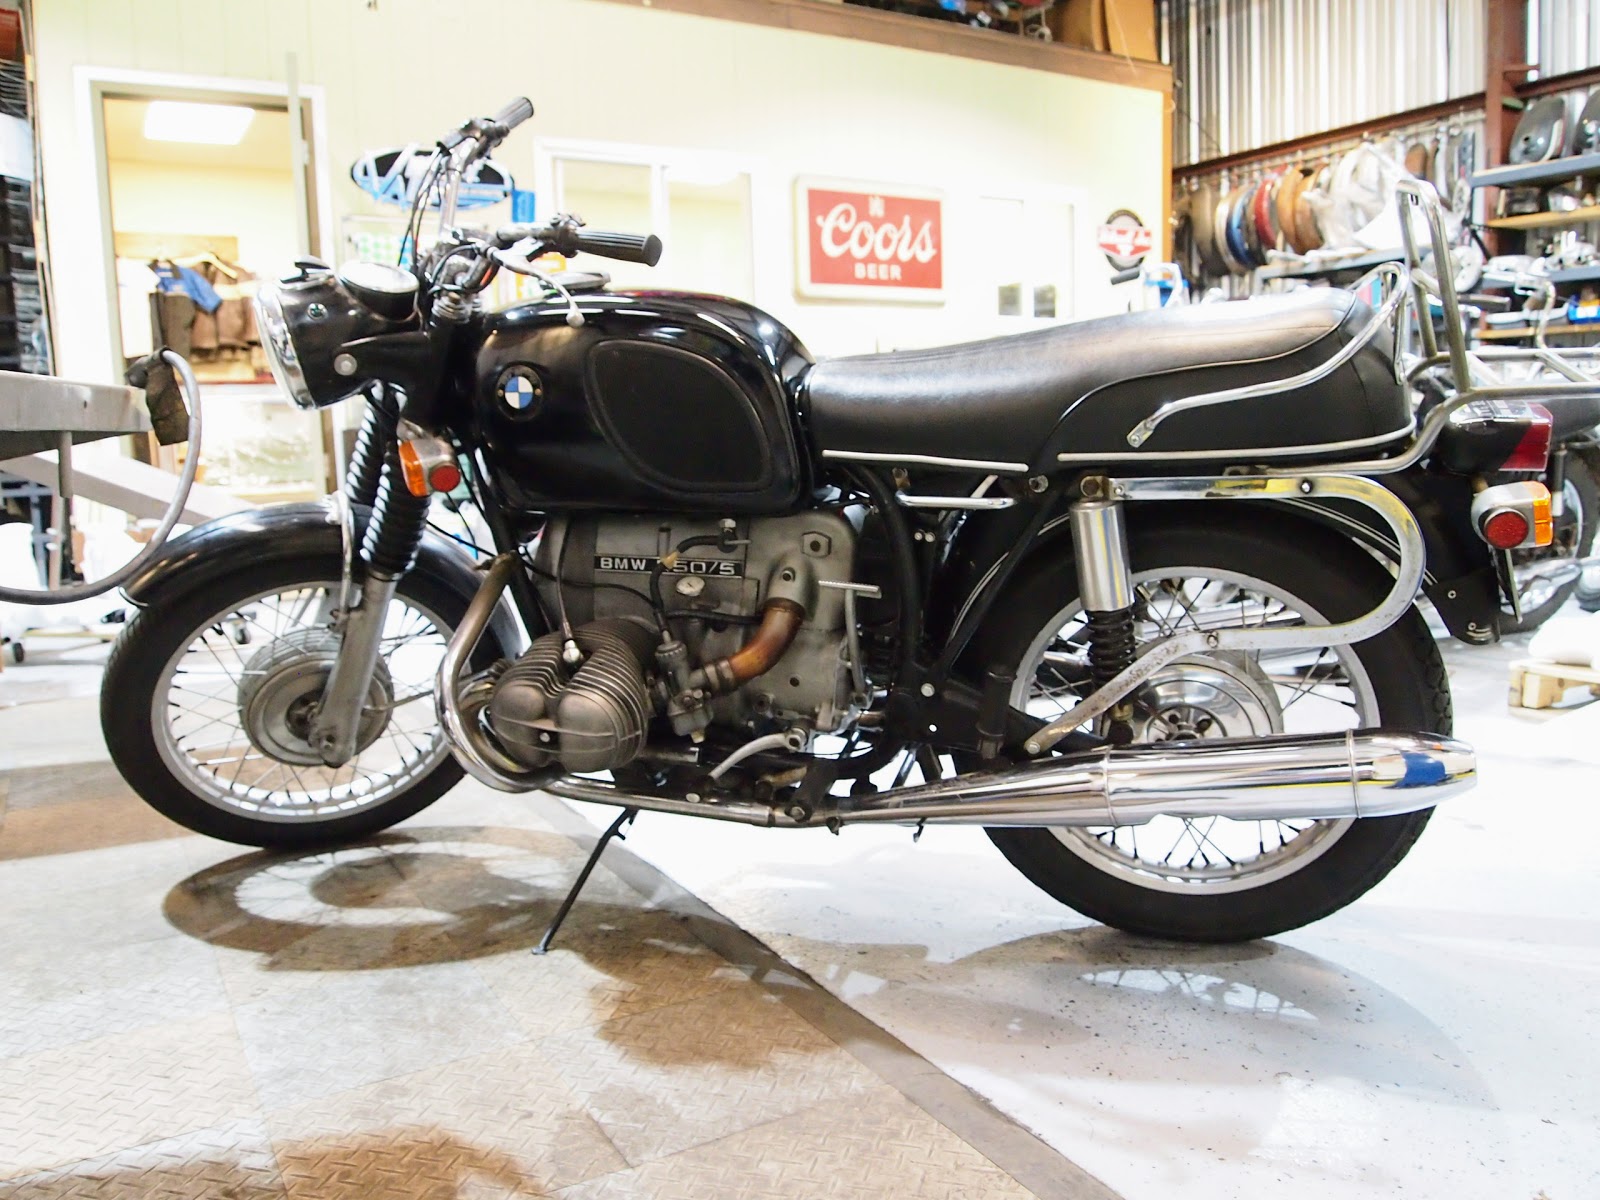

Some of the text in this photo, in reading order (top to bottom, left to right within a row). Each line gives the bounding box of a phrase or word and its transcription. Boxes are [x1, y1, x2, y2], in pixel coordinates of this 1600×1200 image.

[816, 203, 937, 263] Coors
[854, 262, 902, 281] BEER
[600, 557, 736, 577] BMW 50/5
